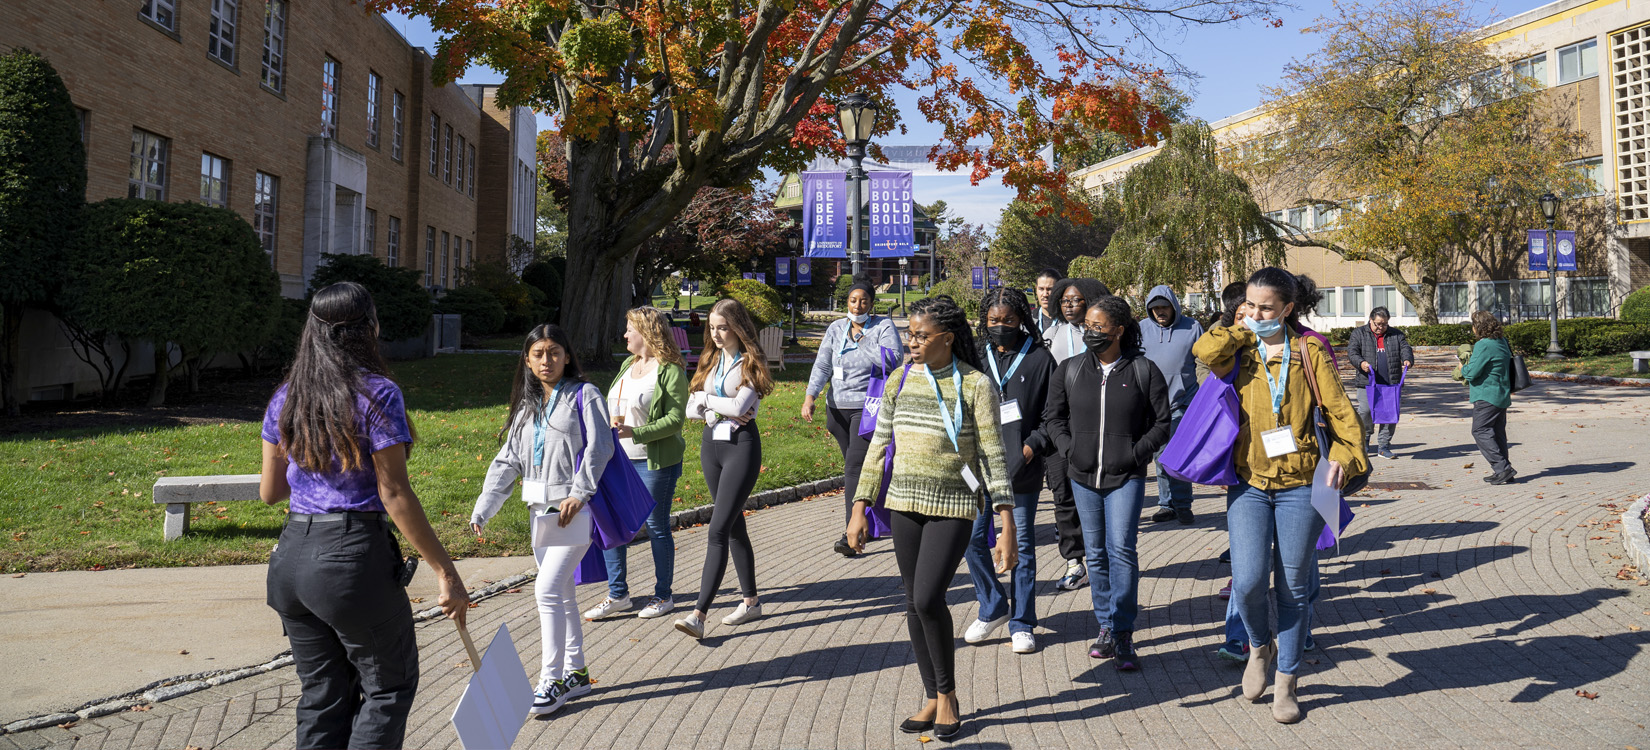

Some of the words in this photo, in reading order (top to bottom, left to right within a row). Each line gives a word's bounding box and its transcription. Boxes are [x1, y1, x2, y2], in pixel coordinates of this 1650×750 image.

[816, 179, 834, 189] BE
[816, 191, 834, 201] BE
[872, 191, 910, 201] BOLD
[816, 203, 834, 213] BE
[872, 203, 910, 213] BOLD
[816, 215, 834, 225] BE
[872, 214, 910, 224] BOLD
[816, 226, 834, 236] BE
[872, 226, 910, 236] BOLD
